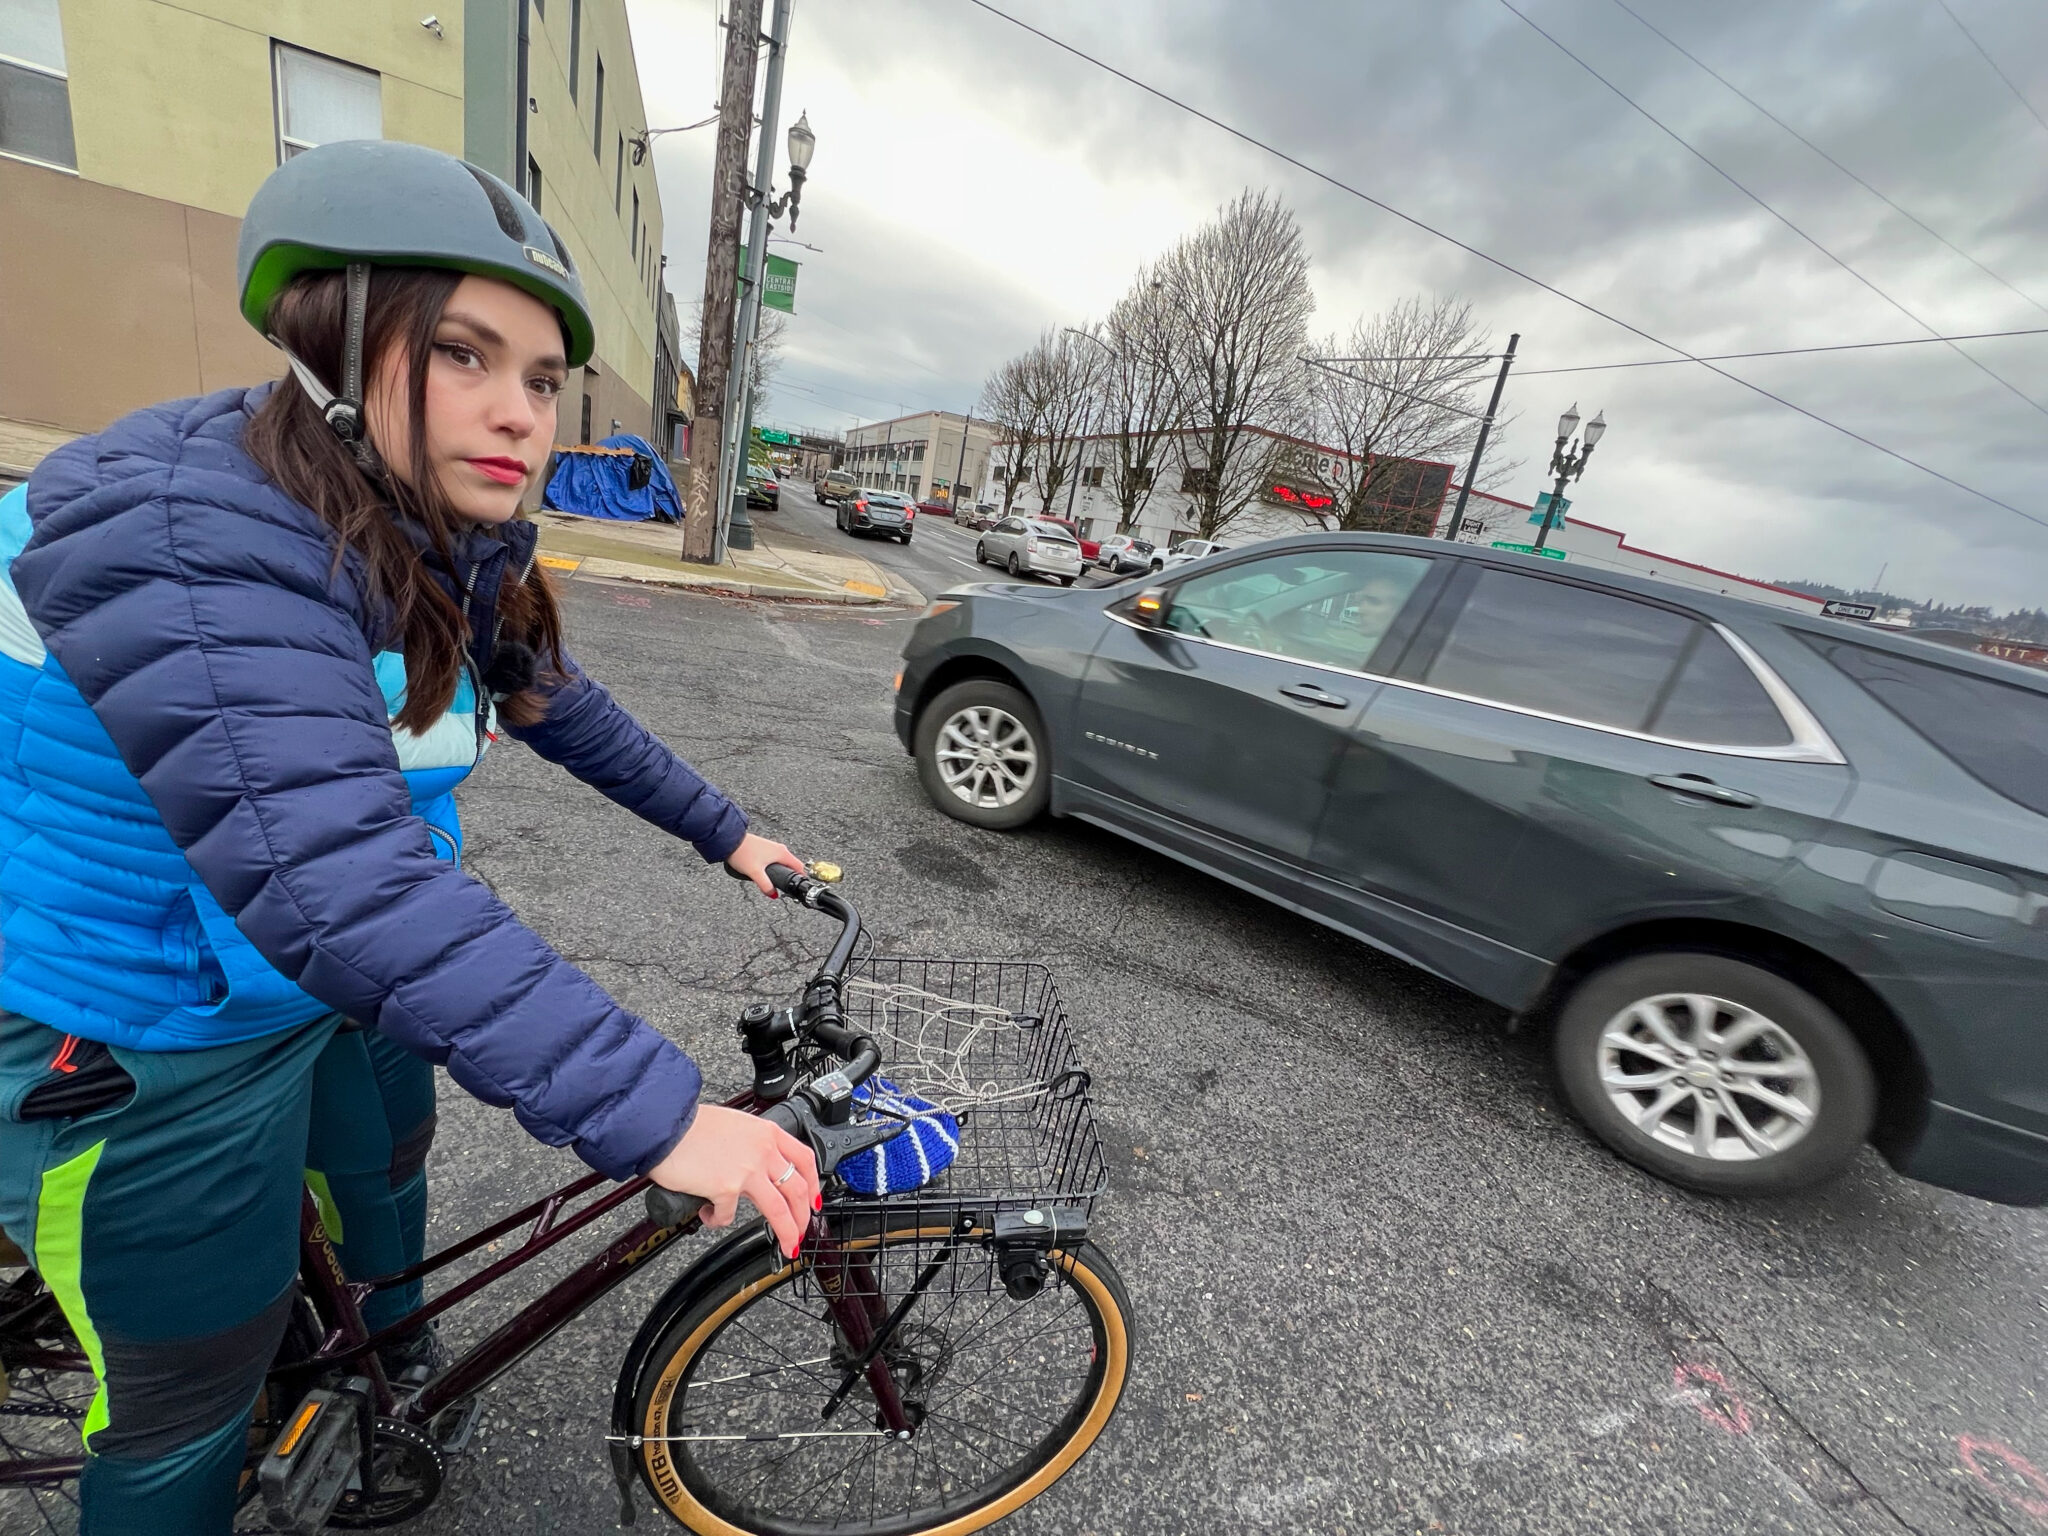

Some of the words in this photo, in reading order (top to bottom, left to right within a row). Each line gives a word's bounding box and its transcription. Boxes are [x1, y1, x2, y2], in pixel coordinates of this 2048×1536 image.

[767, 276, 794, 286] CENTRAL
[1837, 605, 1851, 614] ONE
[1853, 608, 1870, 617] WAY
[1084, 731, 1160, 761] EQUINOX
[652, 1422, 661, 1456] horzon
[651, 1455, 679, 1499] WTB
